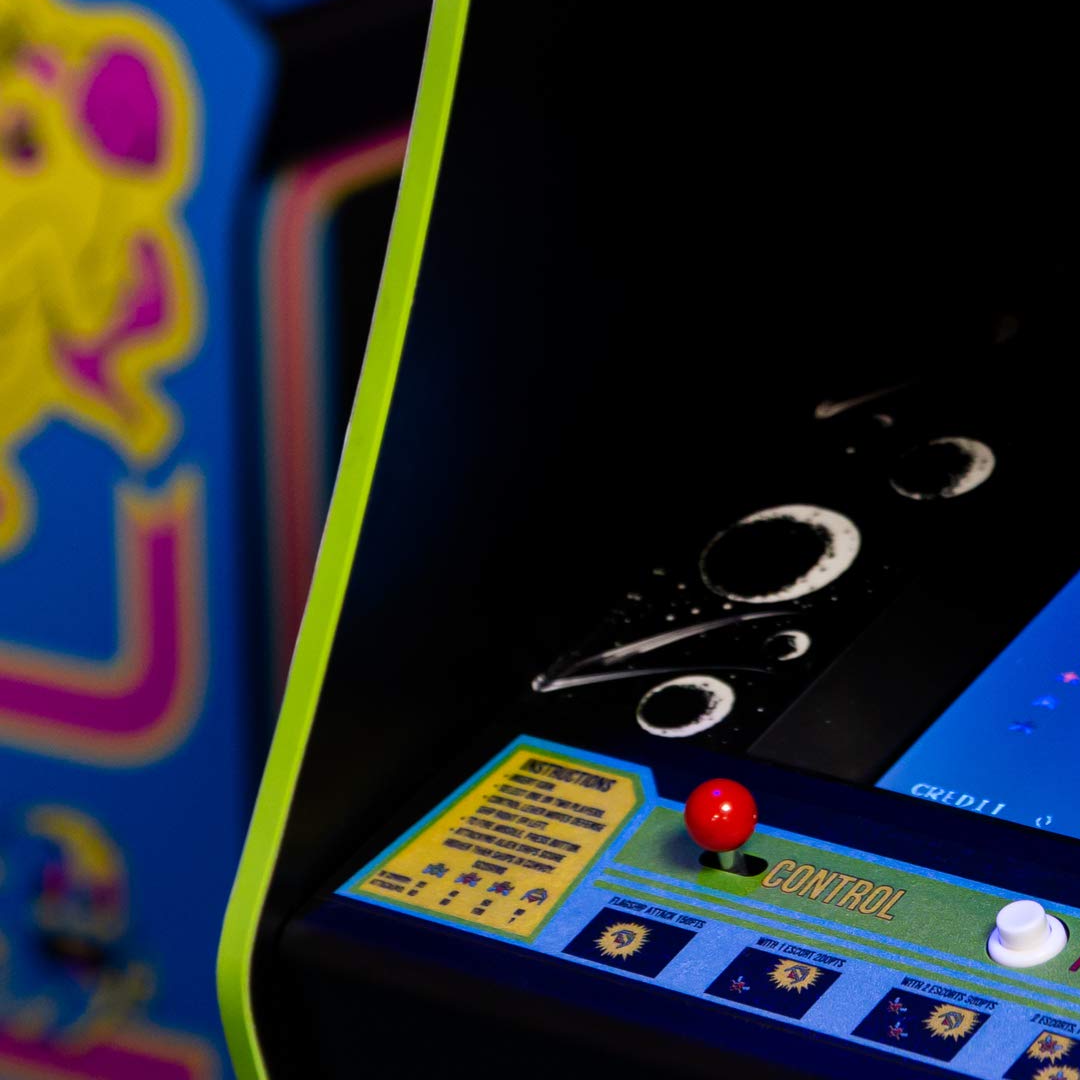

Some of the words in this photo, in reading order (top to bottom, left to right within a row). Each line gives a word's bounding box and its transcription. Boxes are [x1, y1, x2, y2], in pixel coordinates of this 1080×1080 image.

[761, 859, 906, 920] CONTROL
[644, 906, 679, 921] ATTACK
[756, 937, 780, 950] WITH
[783, 944, 816, 960] ESCORT
[901, 976, 925, 991] WITH
[928, 985, 967, 1002] ESCORTS
